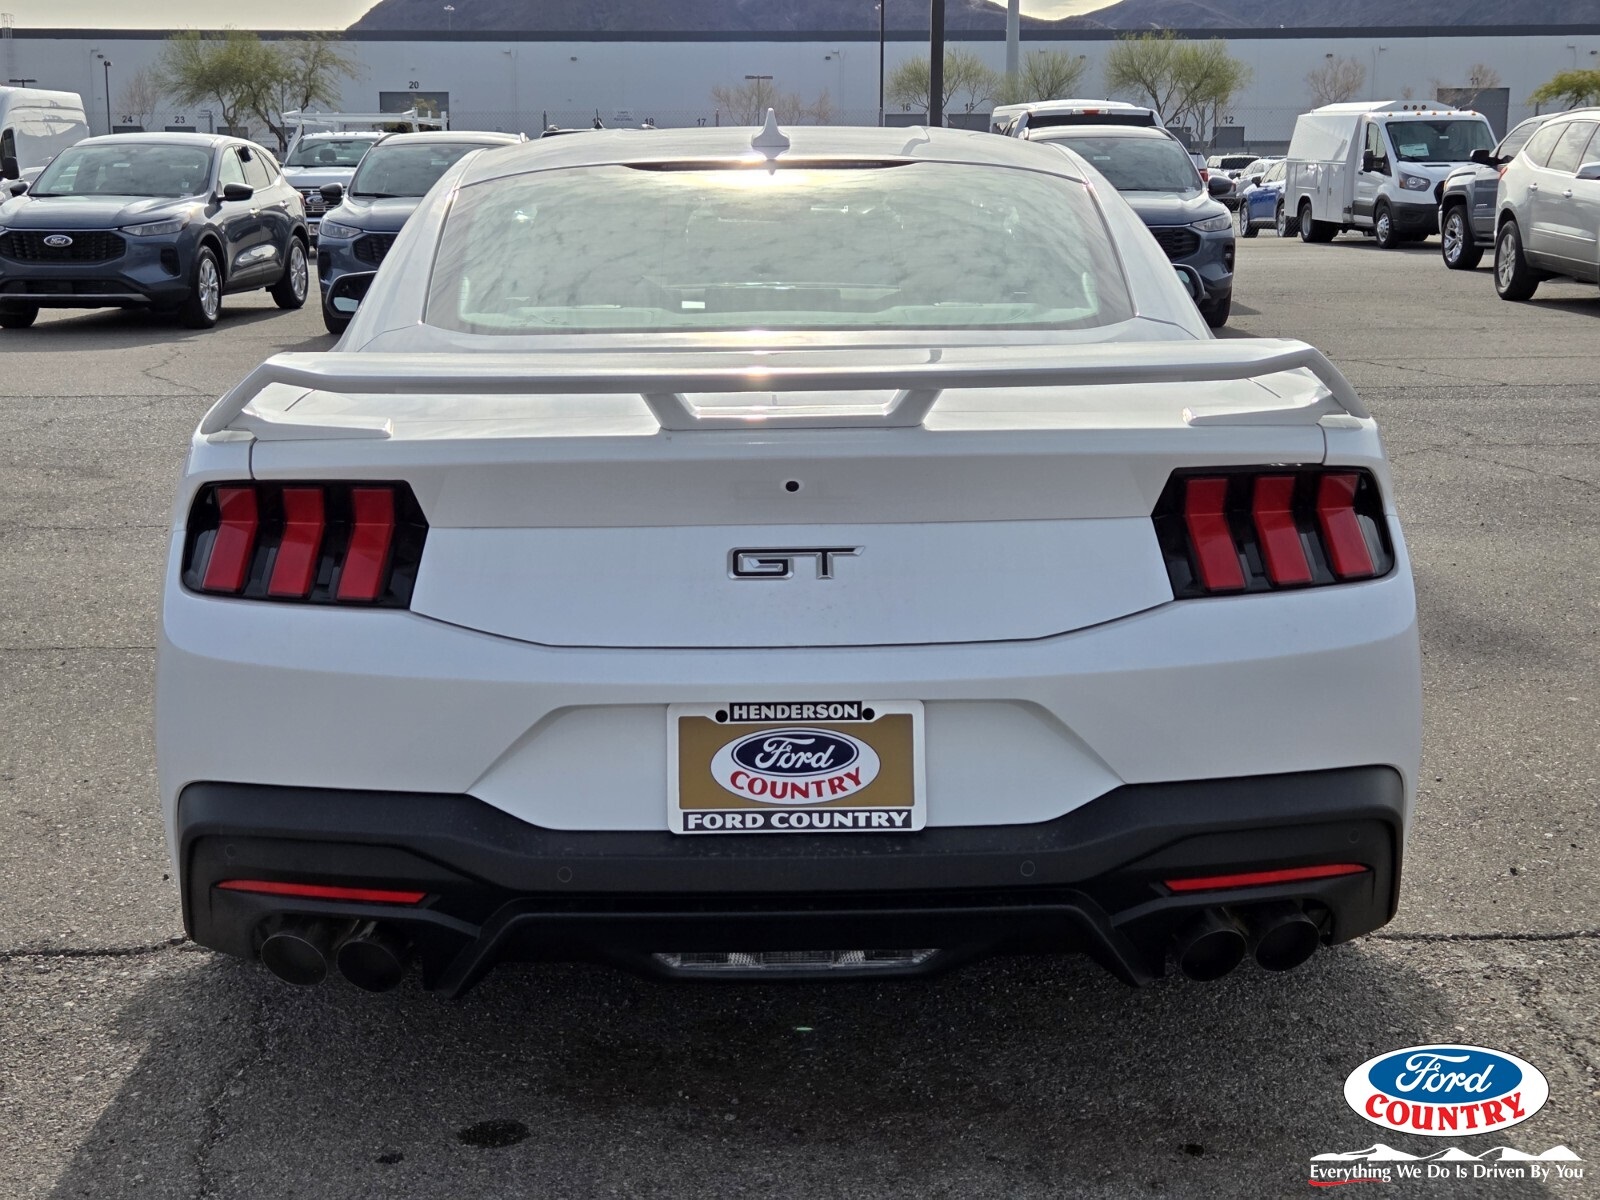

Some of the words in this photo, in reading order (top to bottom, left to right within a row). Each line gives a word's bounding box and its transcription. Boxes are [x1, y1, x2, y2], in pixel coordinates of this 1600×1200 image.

[408, 80, 420, 89] 20
[901, 103, 911, 112] 16
[122, 115, 133, 124] 24
[174, 115, 185, 124] 23
[697, 118, 707, 126] 17
[1223, 116, 1234, 124] 12
[727, 545, 866, 580] GT
[733, 703, 859, 720] HENDERSON
[754, 737, 836, 769] Ford
[730, 767, 862, 799] COUNTRY
[687, 813, 765, 830] FORD
[770, 811, 909, 829] COUNTRY
